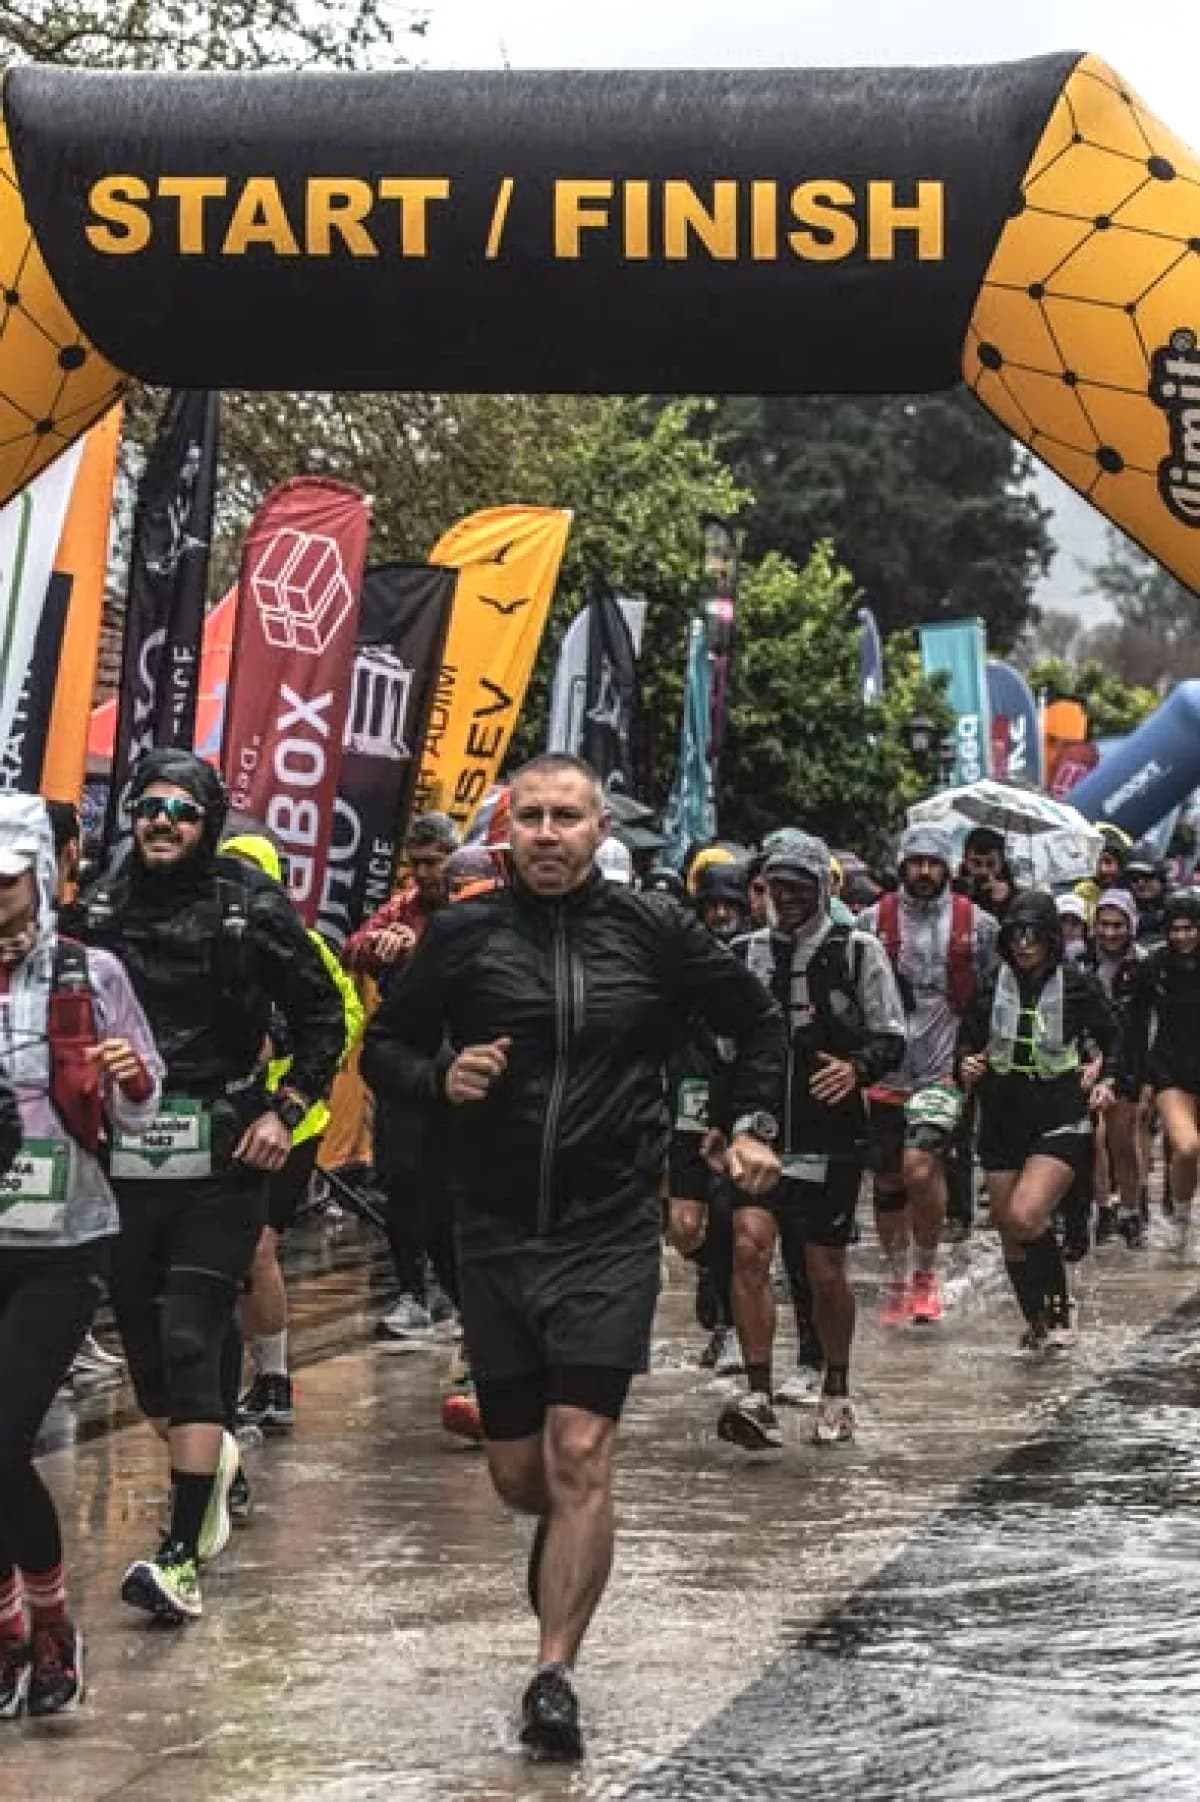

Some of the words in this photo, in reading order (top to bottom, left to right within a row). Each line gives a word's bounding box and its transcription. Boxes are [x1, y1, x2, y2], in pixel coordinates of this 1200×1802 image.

[86, 175, 449, 256] START
[487, 178, 514, 258] /
[554, 179, 945, 261] FINISH
